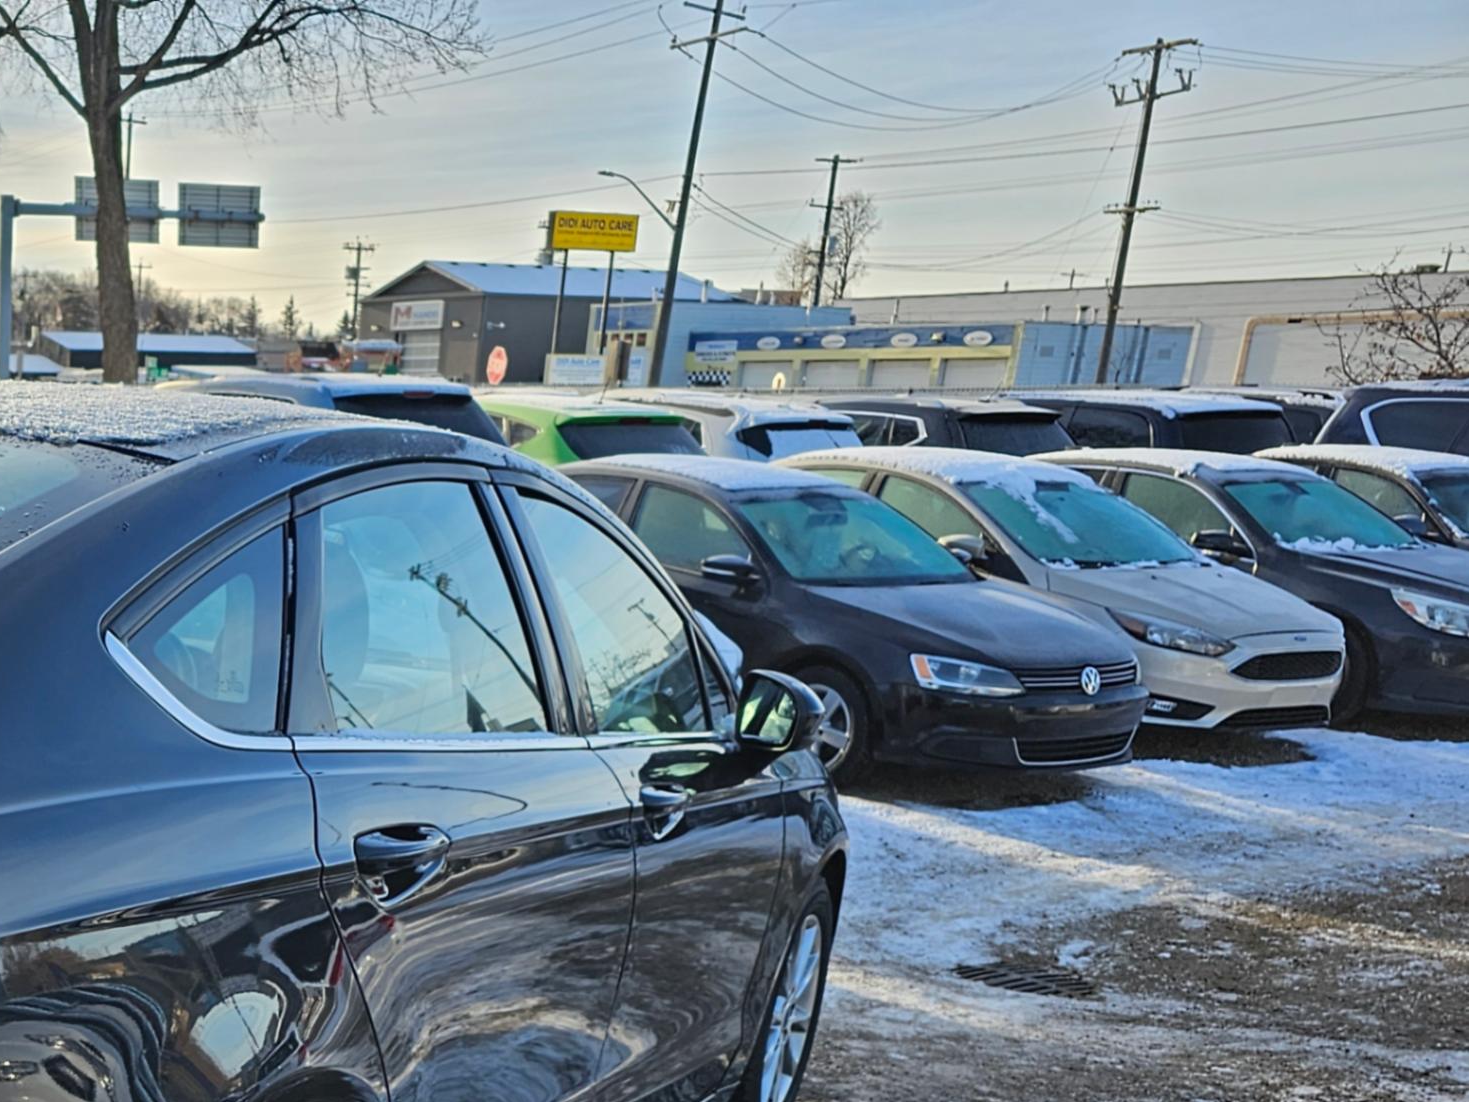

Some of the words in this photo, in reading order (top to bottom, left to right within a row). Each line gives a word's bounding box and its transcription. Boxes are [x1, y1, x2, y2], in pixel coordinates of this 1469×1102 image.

[558, 217, 578, 228] DIDI
[581, 218, 606, 230] AUTO
[609, 219, 634, 232] CARE
